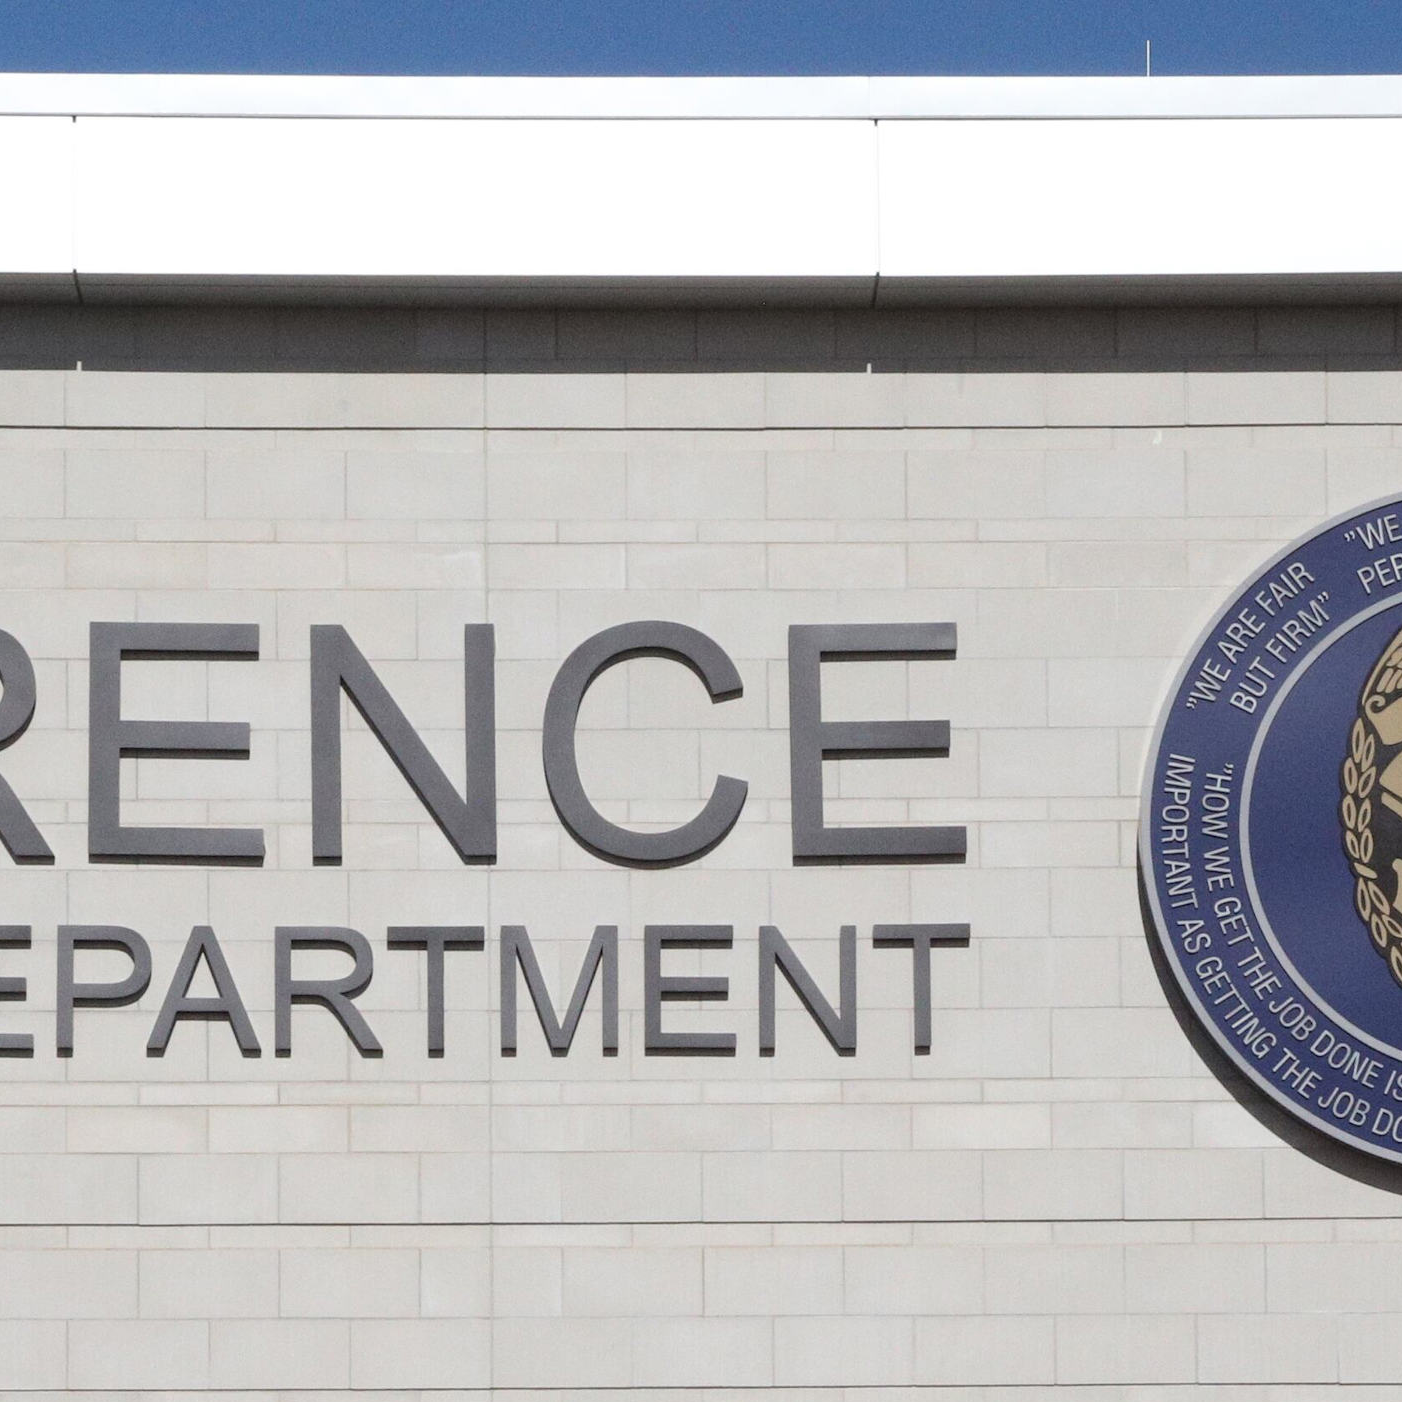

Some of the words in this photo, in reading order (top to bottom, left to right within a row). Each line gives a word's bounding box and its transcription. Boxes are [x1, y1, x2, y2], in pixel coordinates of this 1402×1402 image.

[1217, 608, 1266, 665] ARE
[1254, 561, 1315, 616] FAIR
[1229, 656, 1276, 715] BUT
[1161, 753, 1199, 910] IMPORTANT
[1204, 845, 1235, 893] WE
[1176, 918, 1212, 955] AS
[1214, 897, 1254, 948] GET
[1238, 940, 1282, 1002] THE
[1195, 954, 1278, 1060] GETTING
[1269, 996, 1316, 1043] JOB
[1272, 1044, 1322, 1099] THE
[1310, 1029, 1385, 1089] DONE
[1317, 1086, 1370, 1128] JOB
